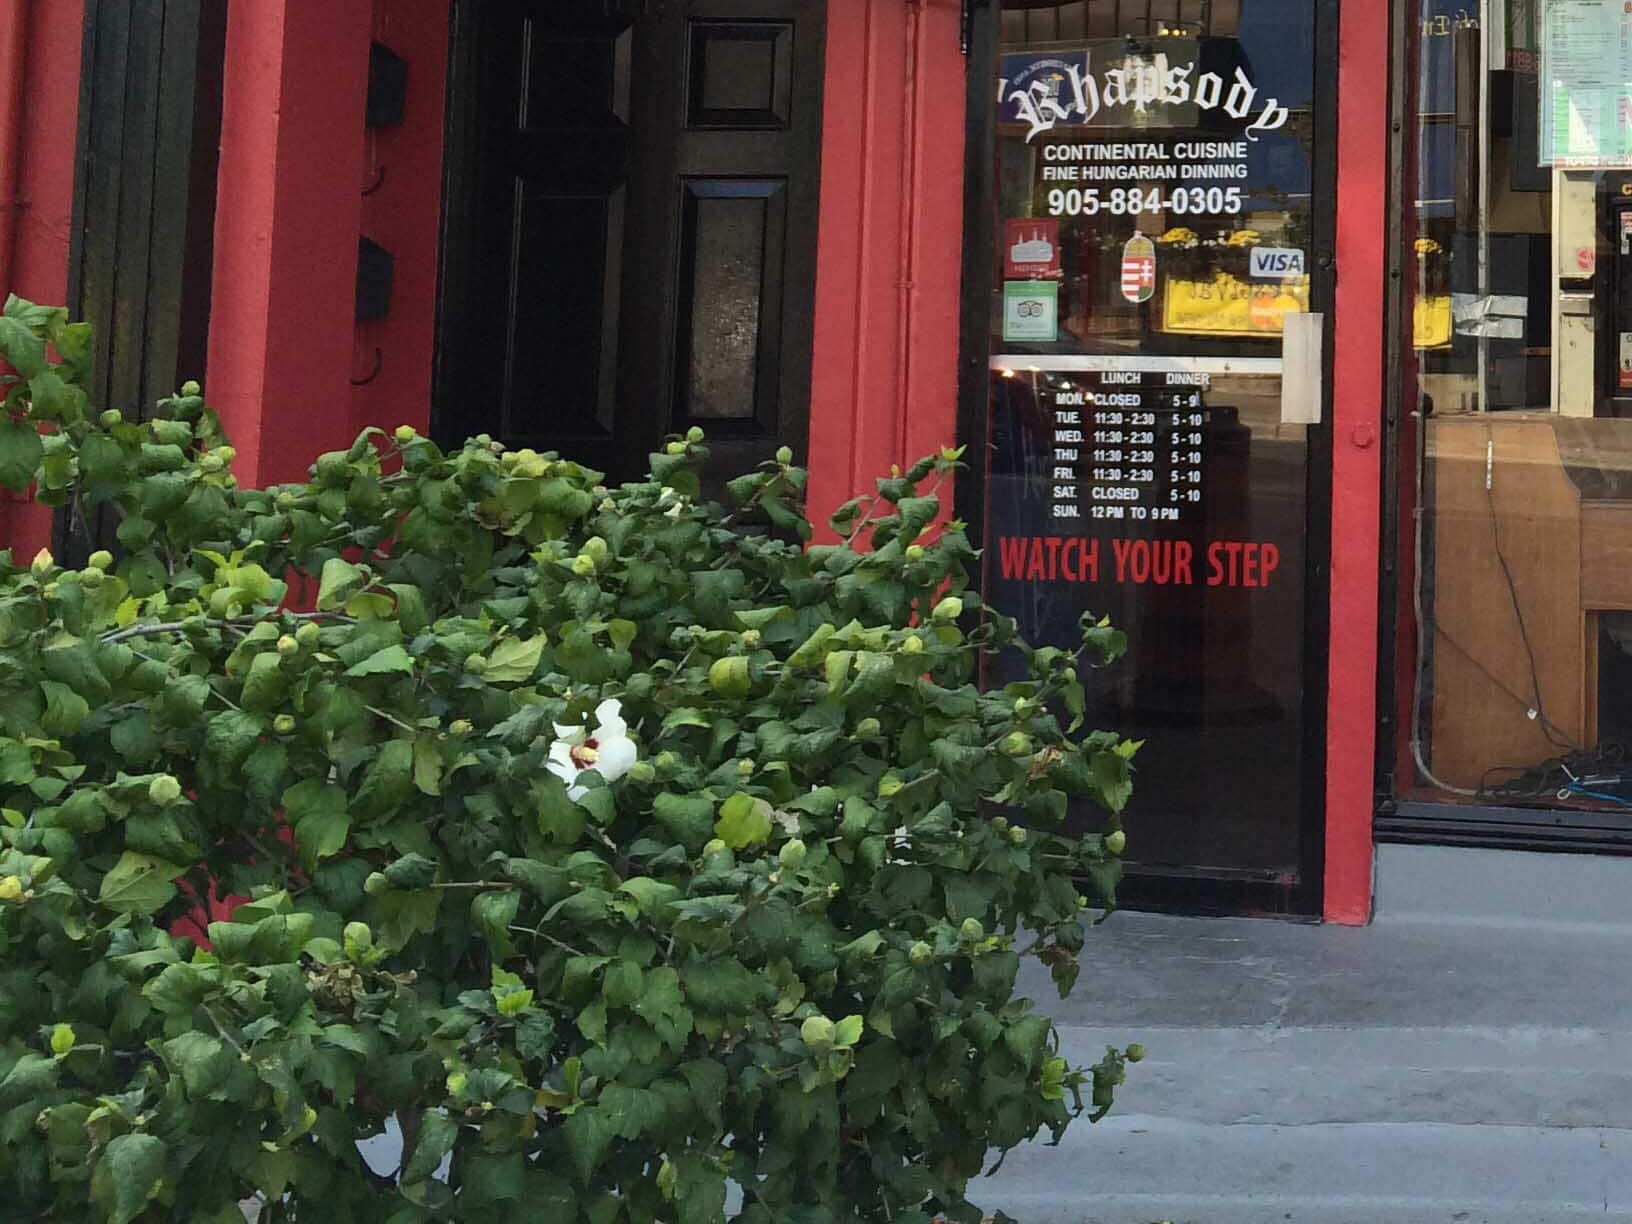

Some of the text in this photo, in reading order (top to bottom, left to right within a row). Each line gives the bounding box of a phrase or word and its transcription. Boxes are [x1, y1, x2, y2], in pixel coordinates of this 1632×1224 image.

[1008, 61, 1289, 144] Rhapsody
[1043, 142, 1248, 161] CONTINENTAL CUISINE
[1043, 164, 1248, 181] FINE HUNGARIAN DINNING
[1049, 186, 1242, 216] 905-884-0305
[1255, 252, 1301, 272] VISA
[1101, 372, 1142, 385] LUNCH
[1166, 372, 1210, 385] DINNER
[1055, 392, 1142, 406] MON. CLOSED
[1055, 411, 1082, 424] TUE.
[1094, 412, 1123, 425] 11:30
[1131, 413, 1155, 425] 2:30
[1171, 414, 1180, 426] 5
[1190, 414, 1202, 426] 10
[1054, 430, 1085, 443] WED.
[1094, 431, 1123, 443] 11:30
[1130, 432, 1154, 444] 2:30
[1171, 433, 1180, 445] 5
[1190, 433, 1202, 445] 10
[1054, 448, 1078, 461] THU
[1093, 449, 1122, 462] 11:30
[1129, 450, 1154, 463] 2:30
[1171, 451, 1179, 463] 5
[1189, 451, 1201, 464] 10
[1053, 467, 1076, 480] FRI.
[1093, 468, 1122, 481] 11:30
[1129, 469, 1154, 481] 2:30
[1170, 470, 1179, 482] 5
[1188, 470, 1201, 483] 10
[1053, 486, 1139, 500] SAT. CLOSED
[1170, 489, 1178, 501] 5
[1188, 489, 1201, 501] 10
[1053, 505, 1080, 518] SUN.
[1131, 507, 1147, 519] TO
[1161, 507, 1180, 520] PM
[1000, 536, 1280, 587] WATCH YOUR STEP
